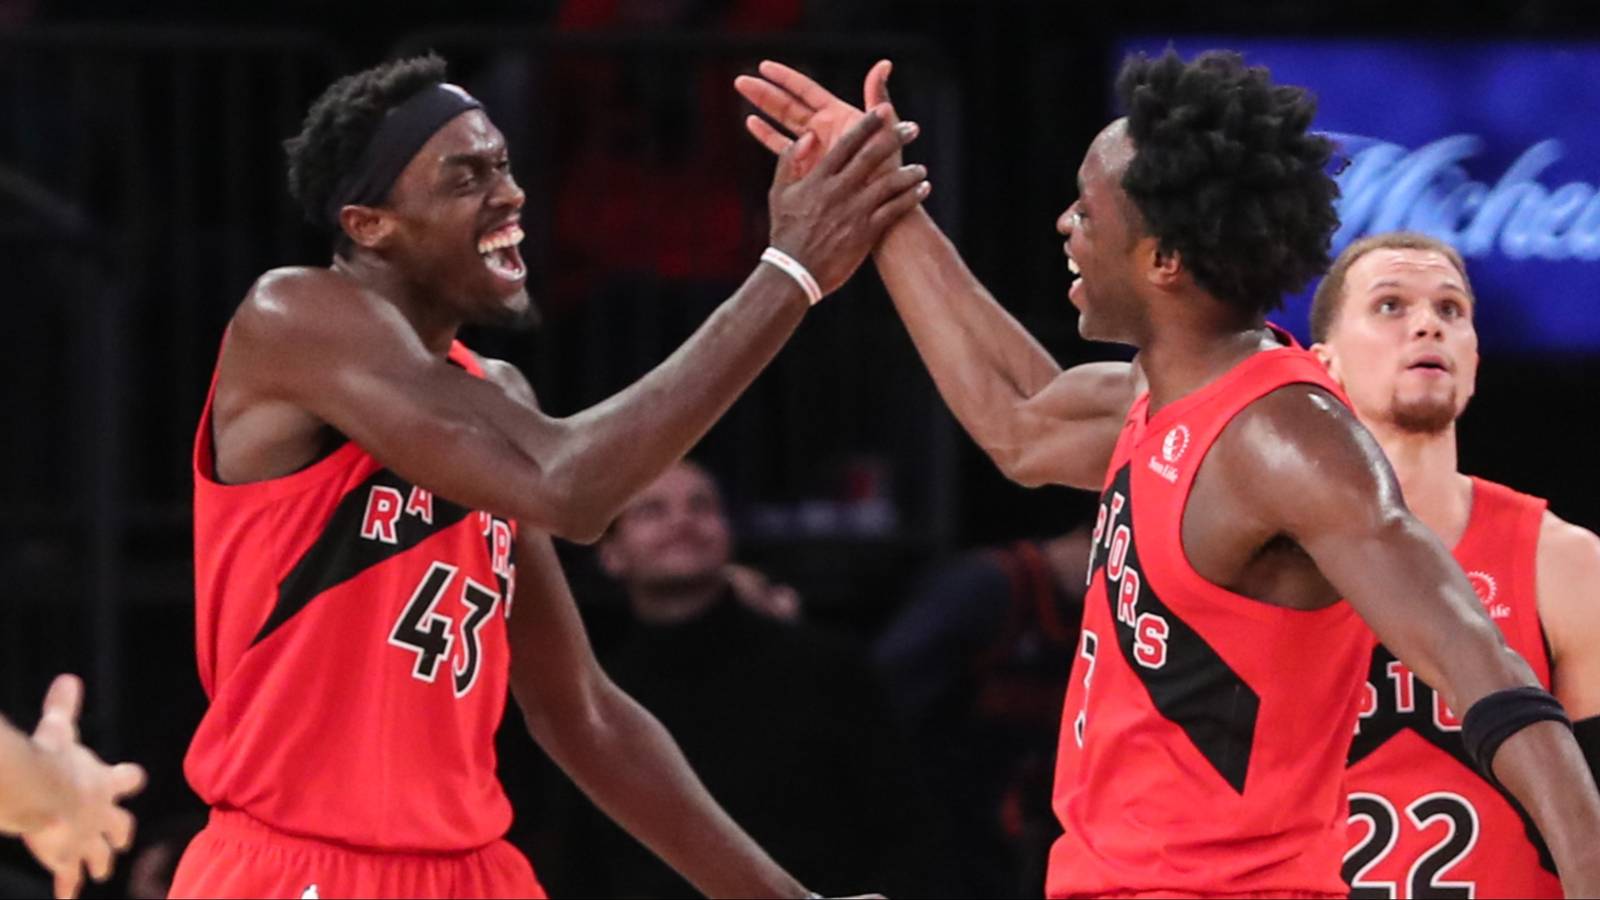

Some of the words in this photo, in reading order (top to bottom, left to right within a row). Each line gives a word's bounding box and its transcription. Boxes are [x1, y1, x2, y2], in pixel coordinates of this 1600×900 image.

[1308, 131, 1600, 260] Miche
[387, 561, 501, 699] 43
[1085, 491, 1169, 669] PTORS
[1340, 792, 1480, 900] 22
